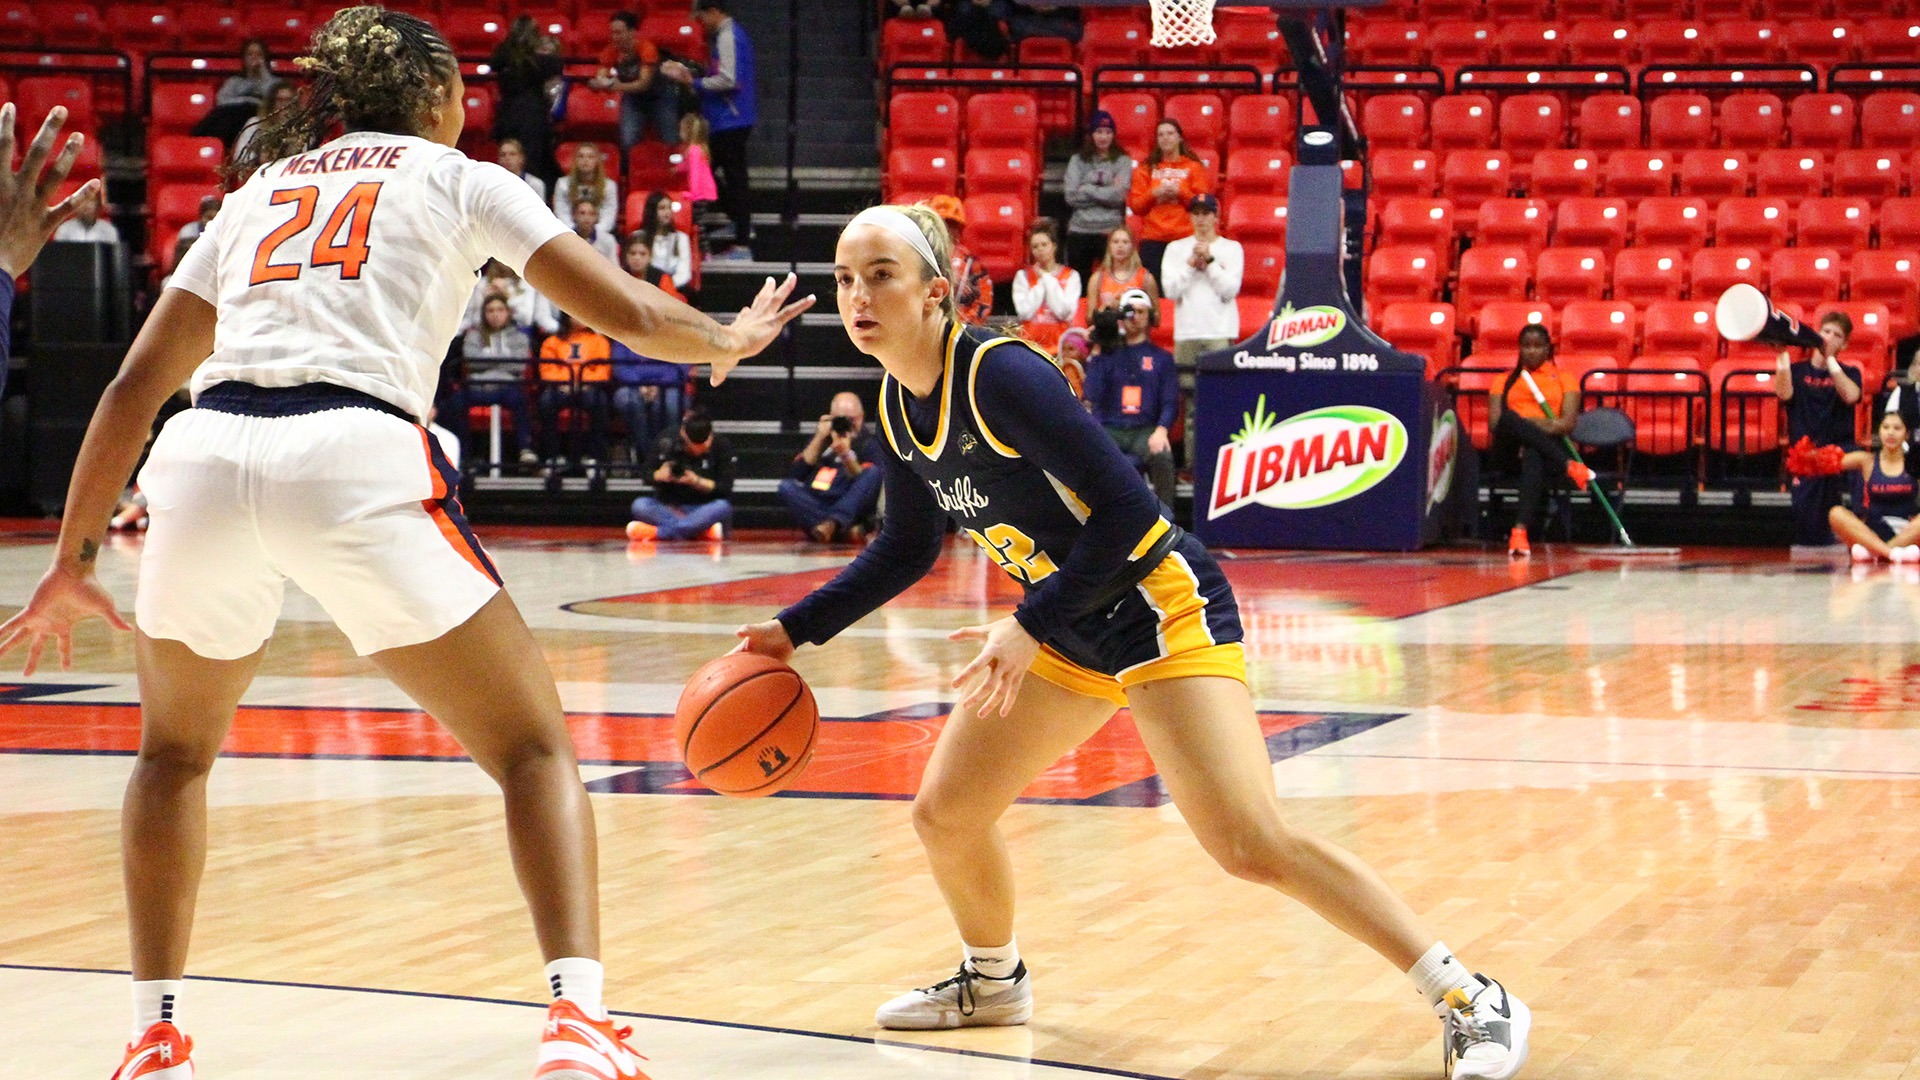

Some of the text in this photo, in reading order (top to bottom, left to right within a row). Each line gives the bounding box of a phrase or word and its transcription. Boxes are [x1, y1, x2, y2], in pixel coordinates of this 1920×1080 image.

[280, 146, 408, 177] McKENZIE
[249, 181, 384, 287] 24
[1270, 313, 1338, 345] LIBMAN
[1233, 350, 1379, 372] Cleaning Since 1896
[1214, 423, 1389, 511] LIBMAN
